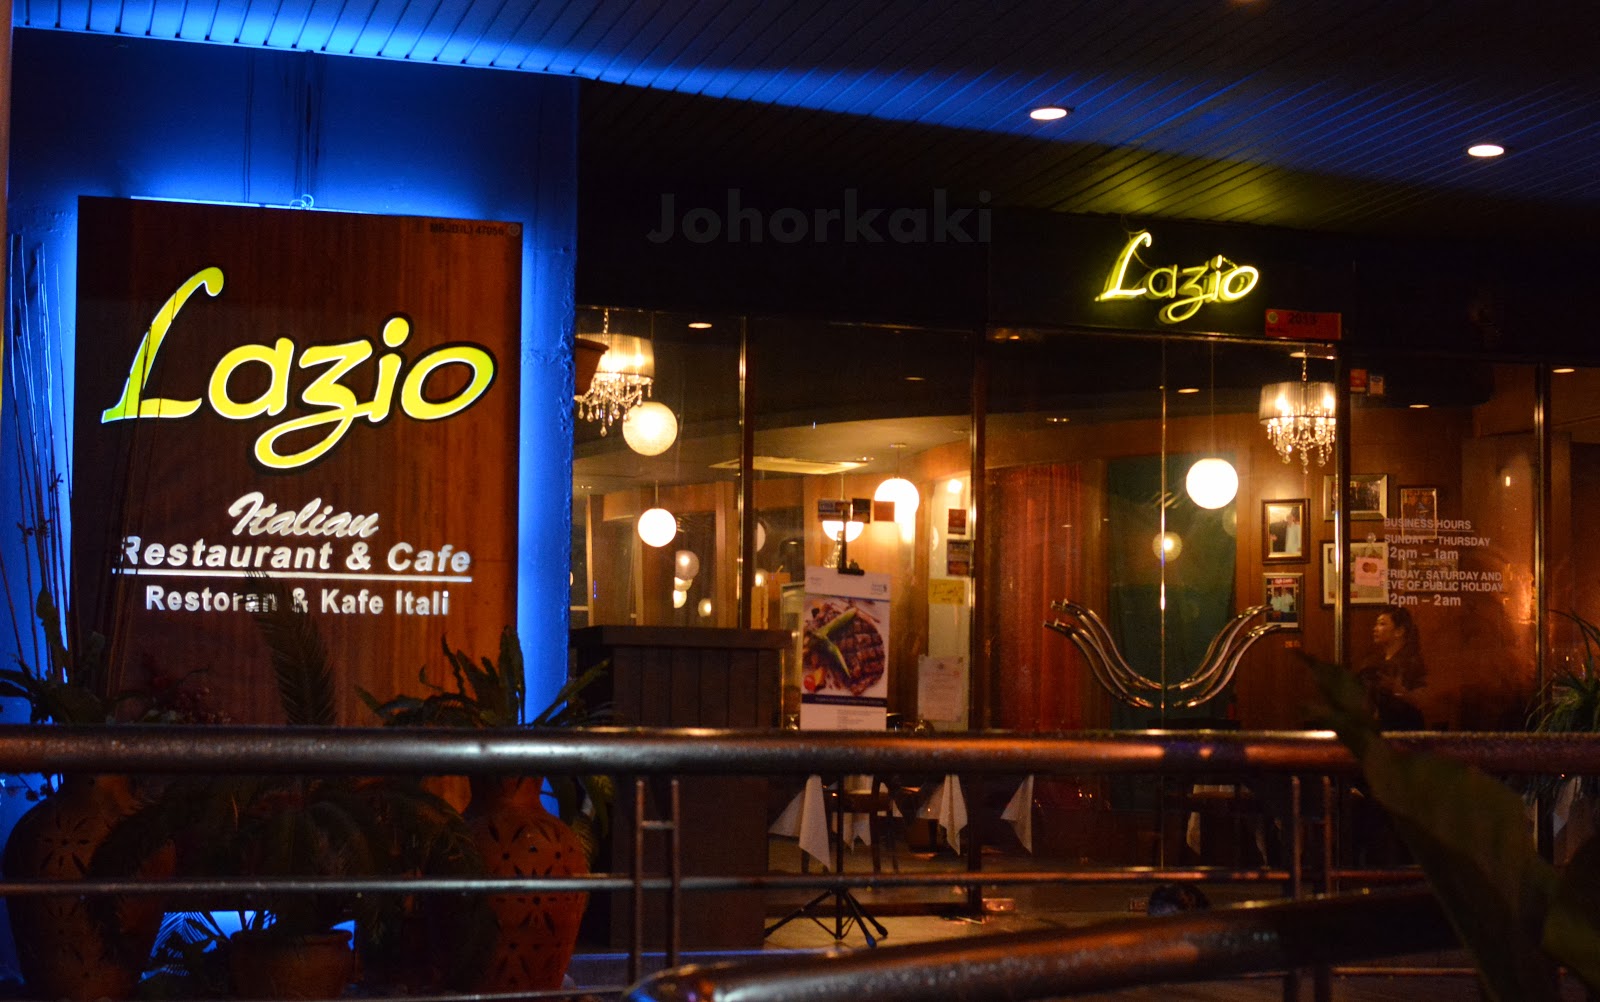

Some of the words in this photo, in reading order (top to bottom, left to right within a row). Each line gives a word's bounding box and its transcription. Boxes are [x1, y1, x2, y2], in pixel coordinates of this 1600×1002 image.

[1096, 230, 1259, 324] Lazio
[101, 267, 494, 469] Lazio
[227, 491, 380, 538] Italian
[1384, 518, 1434, 529] BUSINESS
[1436, 519, 1472, 530] HOURS
[1384, 534, 1426, 545] SUNDAY
[1438, 536, 1491, 547] THURSDAY
[121, 535, 333, 570] Restaurant
[346, 542, 371, 571] &
[387, 542, 471, 573] Cafe
[1434, 548, 1459, 559] 1am
[1426, 570, 1479, 581] SATURDAY
[1481, 571, 1502, 582] AND
[1406, 580, 1421, 591] OF
[1423, 581, 1459, 592] PUBLIC
[1461, 582, 1504, 593] HOLIDAY
[145, 585, 278, 613] Restoran
[321, 588, 384, 614] Kafe
[396, 590, 450, 615] Itali
[1434, 594, 1462, 606] 2am
